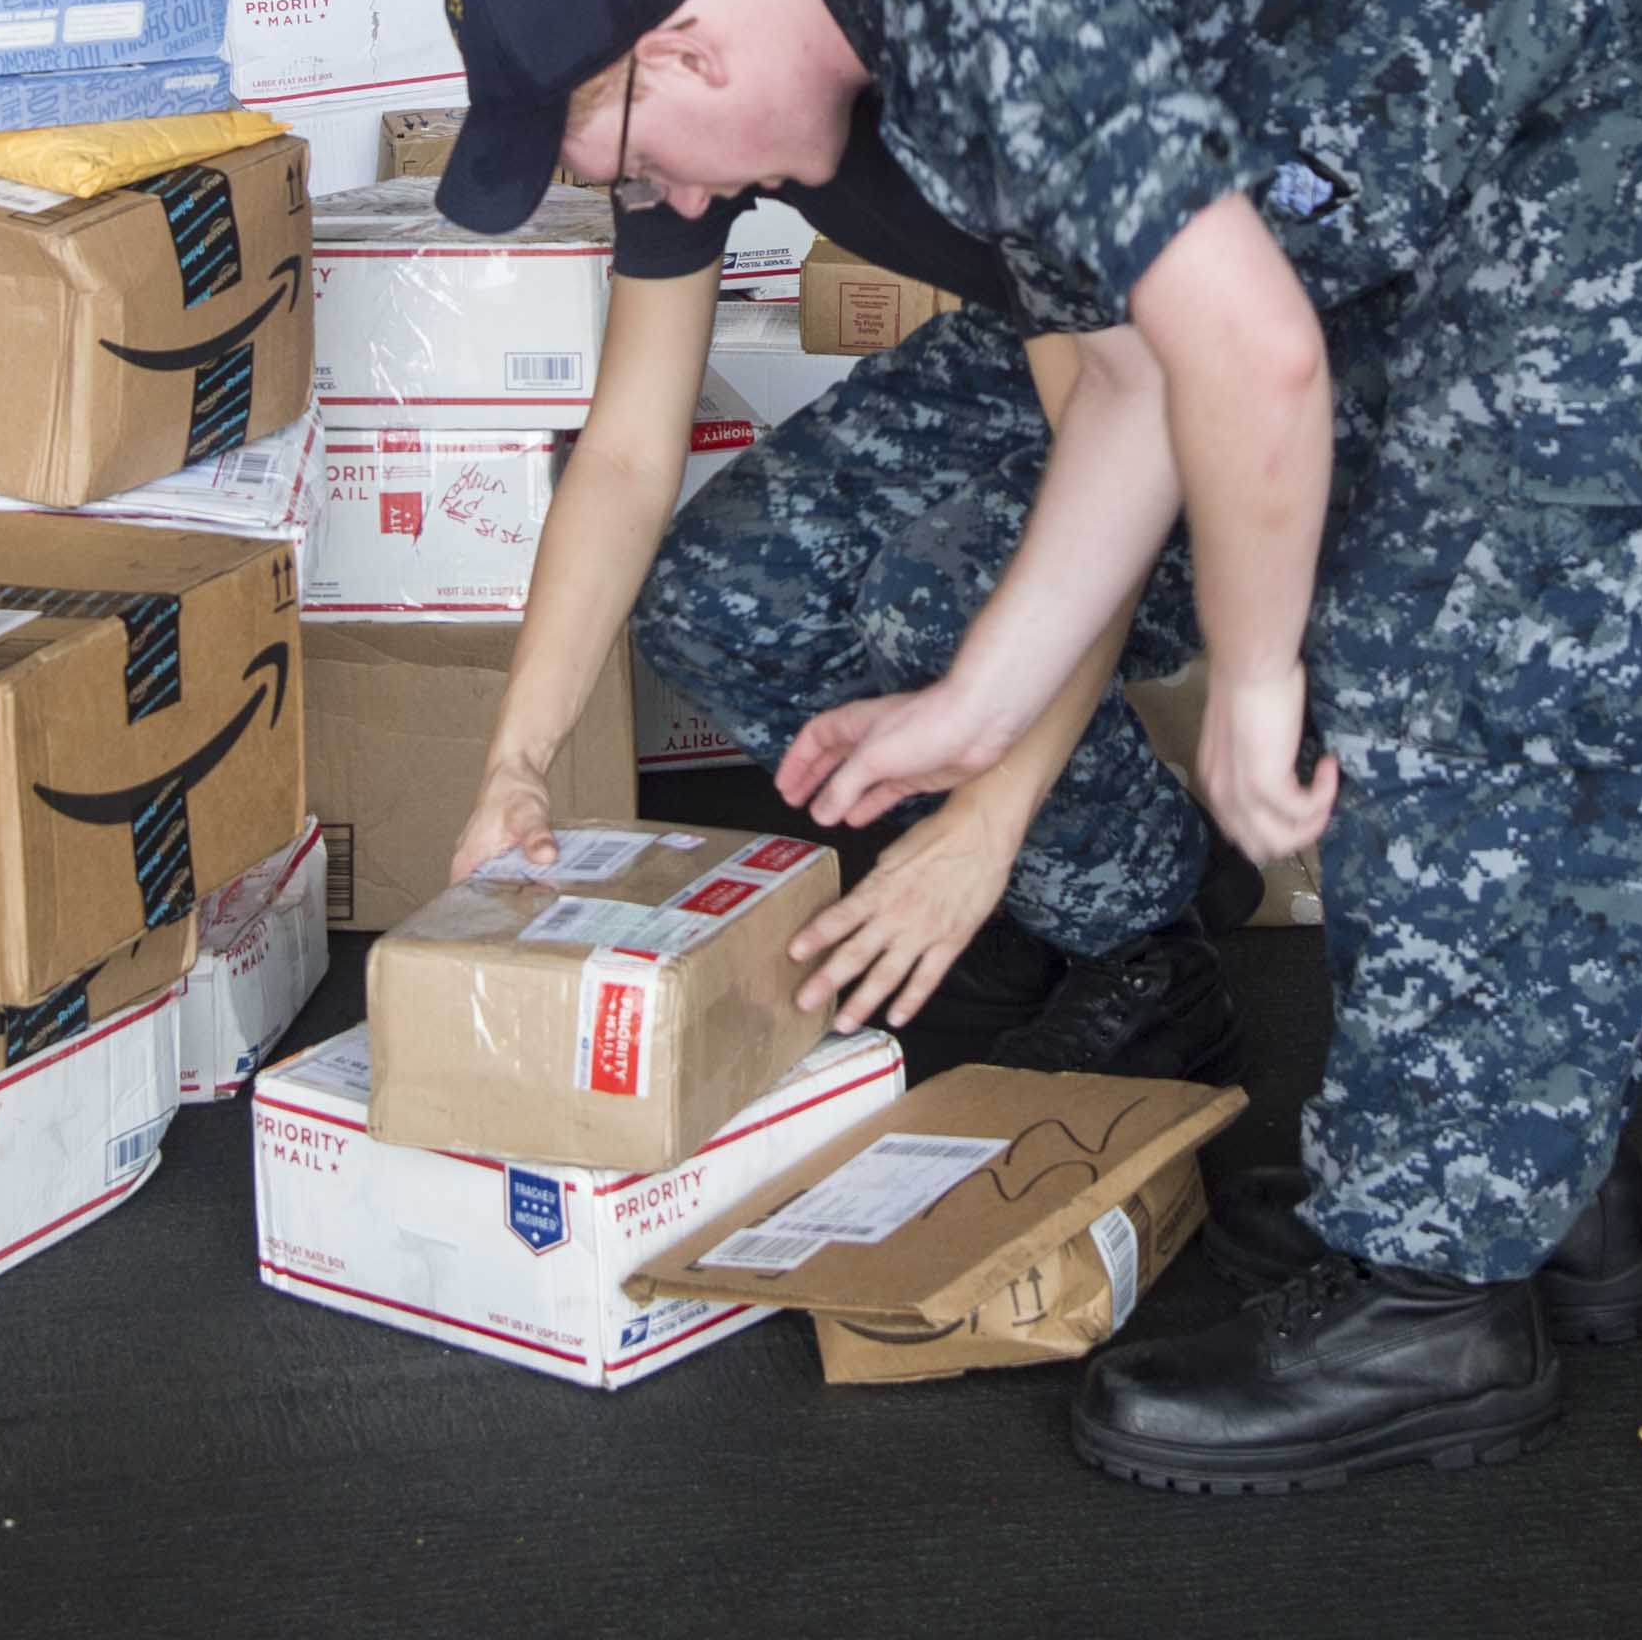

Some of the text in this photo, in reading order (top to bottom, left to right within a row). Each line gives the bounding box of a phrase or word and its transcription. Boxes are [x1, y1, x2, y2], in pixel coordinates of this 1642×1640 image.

[268, 14, 313, 27] MAIL
[331, 486, 369, 501] AIL
[602, 1014, 617, 1060] MAIL
[616, 997, 632, 1083] PRIORITY
[256, 1112, 346, 1155] PRIORITY
[273, 1143, 323, 1172] MAIL
[614, 1168, 702, 1222] PRIORITY
[514, 1209, 558, 1233] INSURED
[639, 1207, 685, 1235] MAIL
[488, 1311, 511, 1326] VISIT
